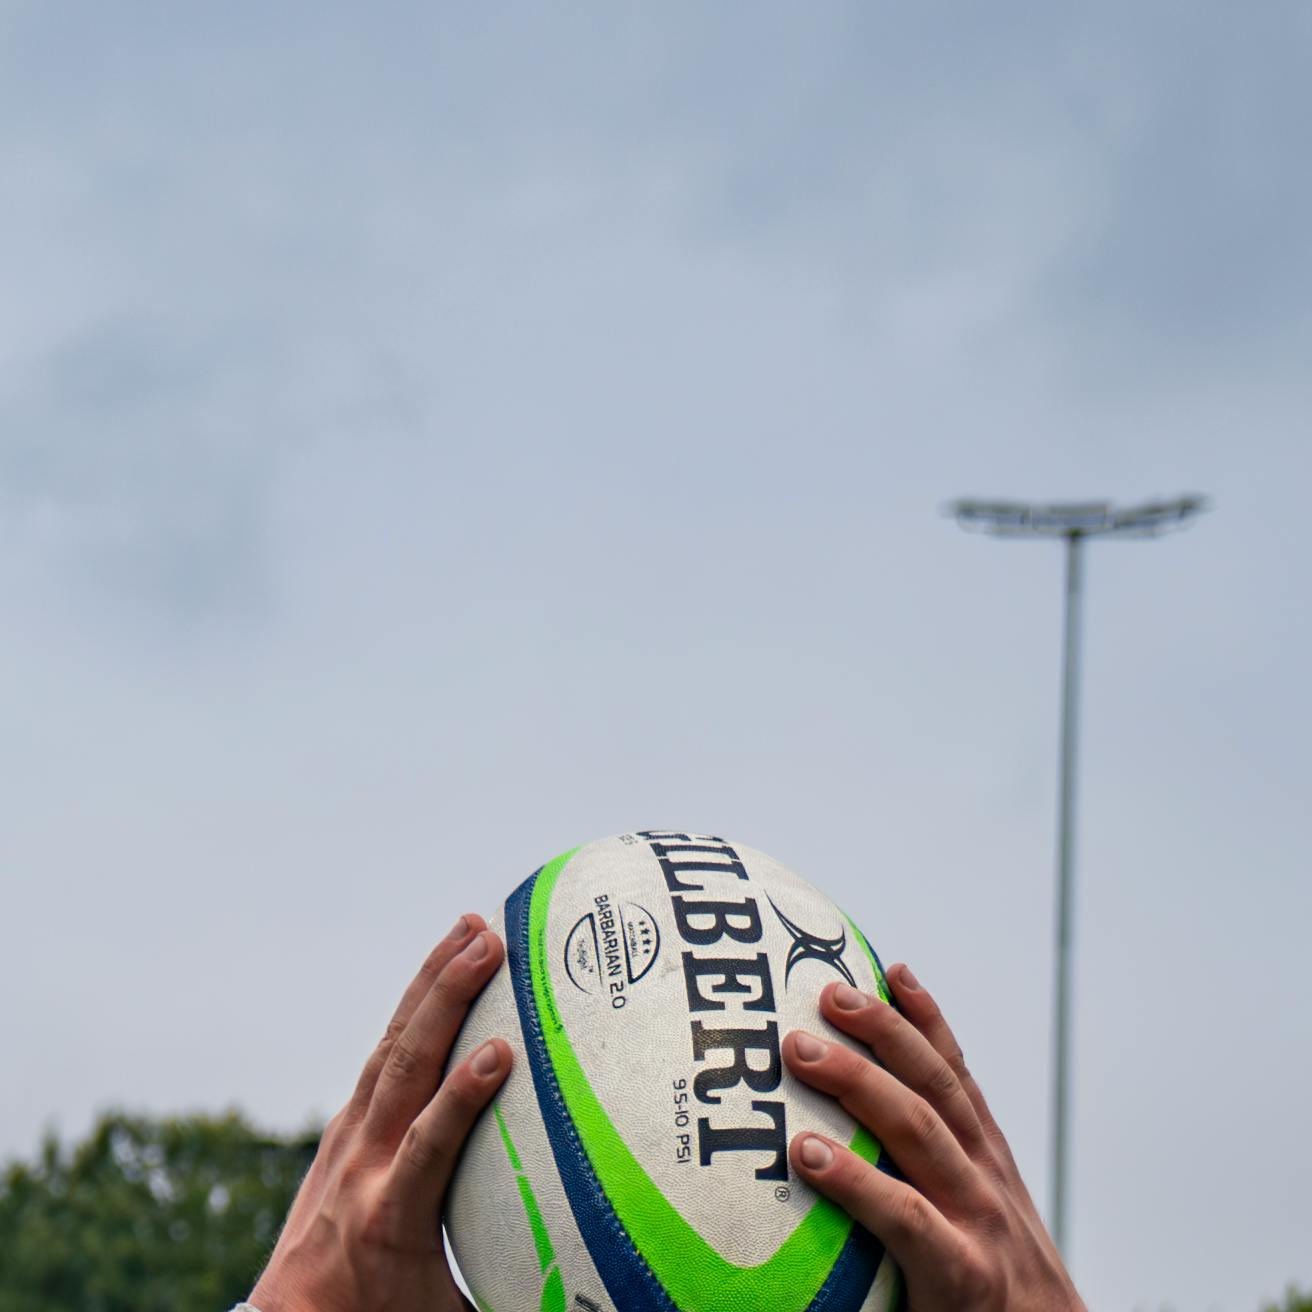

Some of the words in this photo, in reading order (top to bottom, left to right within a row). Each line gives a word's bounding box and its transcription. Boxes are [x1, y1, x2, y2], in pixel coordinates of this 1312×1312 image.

[594, 894, 622, 977] BARBARIAN
[609, 980, 627, 1009] 2.0
[675, 1134, 691, 1163] PSI
